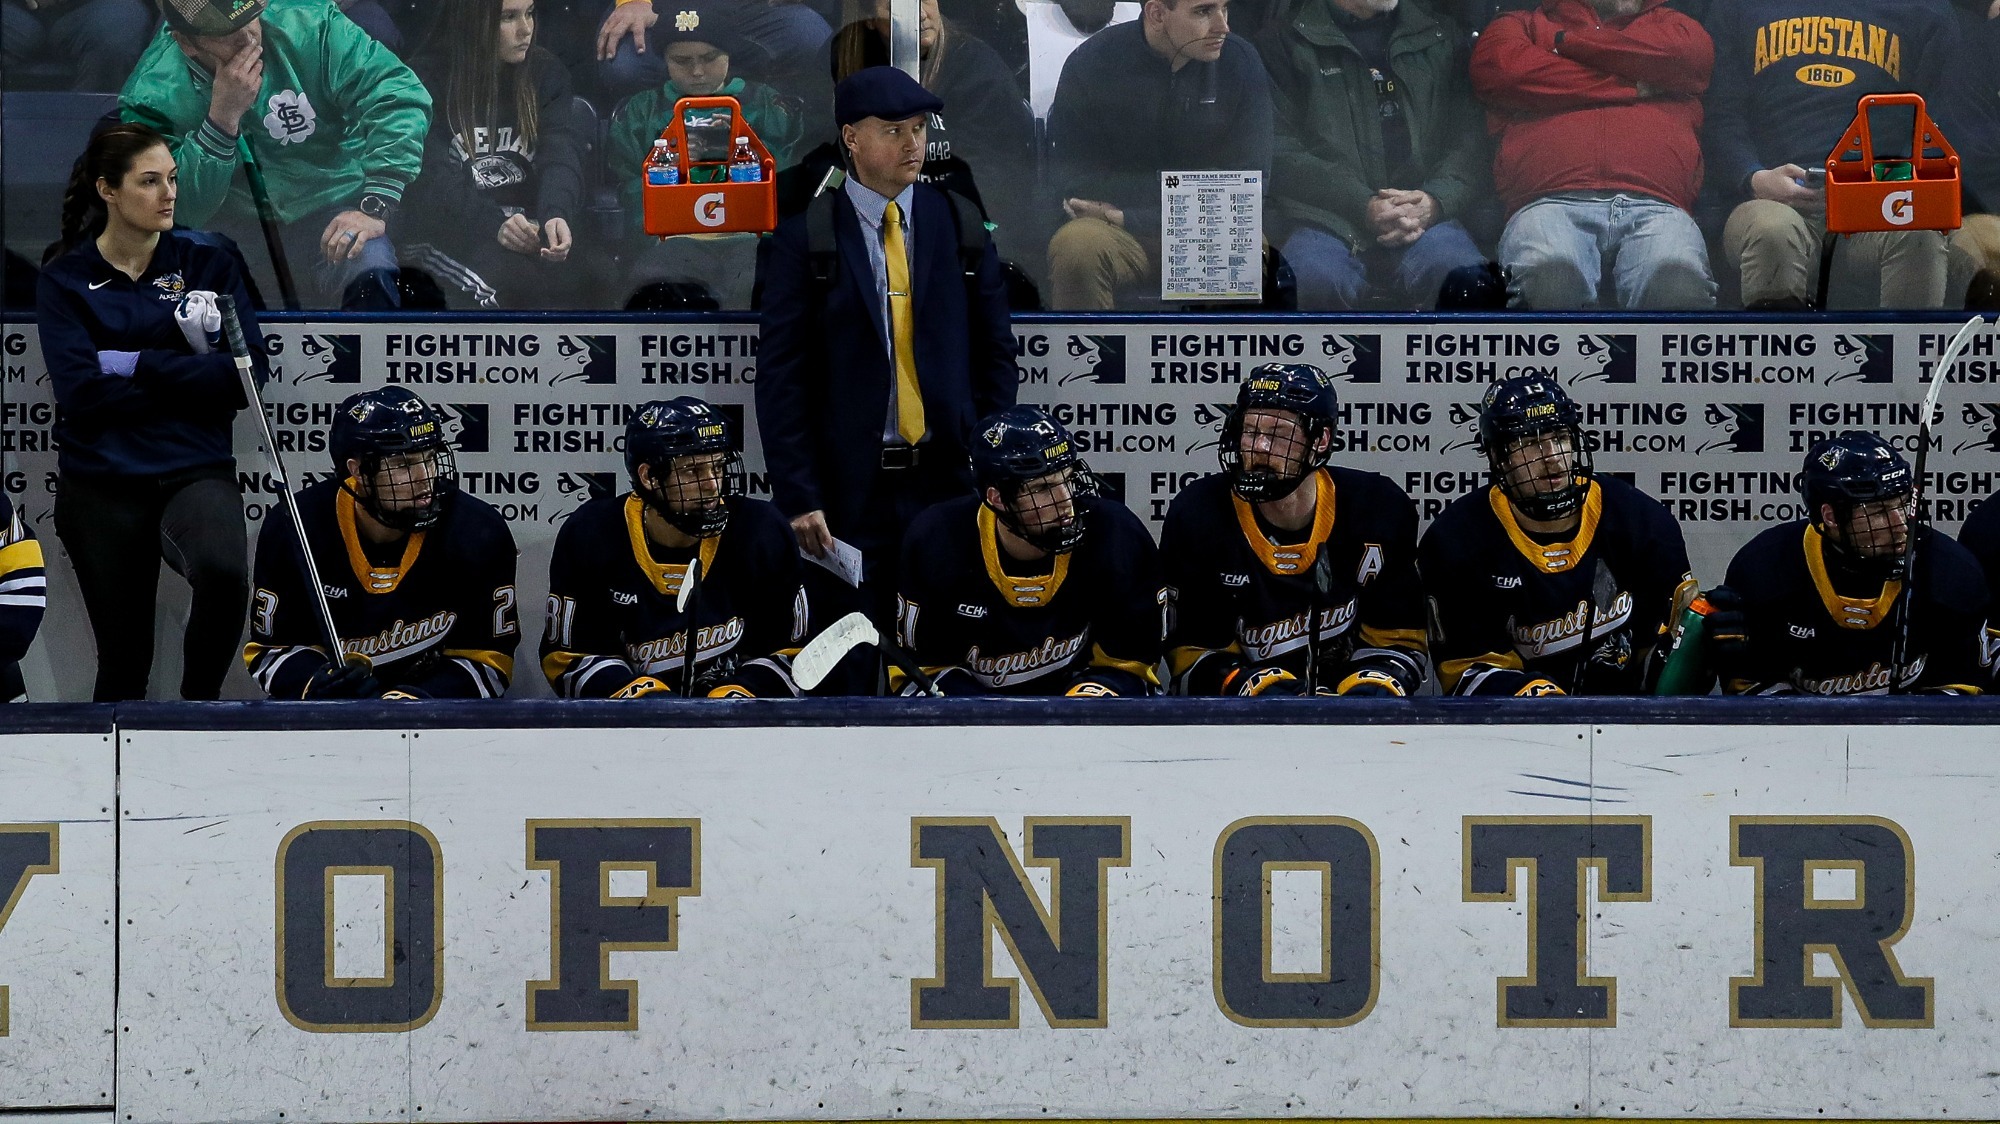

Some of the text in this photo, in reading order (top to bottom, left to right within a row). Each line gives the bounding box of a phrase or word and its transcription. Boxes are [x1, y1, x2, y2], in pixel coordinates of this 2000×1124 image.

[229, 0, 255, 20] IRELAND
[1754, 16, 1901, 82] AUGUSTANA
[1807, 68, 1843, 84] 1860
[694, 192, 726, 227] G
[1882, 190, 1914, 226] G
[386, 334, 540, 357] FIGHTING
[1151, 334, 1305, 357] FIGHTING
[1406, 334, 1560, 357] FIGHTING
[1661, 334, 1816, 357] FIGHTING
[386, 361, 539, 384] IRISH.COM
[1661, 361, 1815, 384] IRISH.COM
[1251, 380, 1280, 391] VIKINGS
[1526, 403, 1556, 418] VIKINGS
[410, 422, 435, 437] VIKINGS
[697, 424, 723, 438] VIKINGS
[1044, 441, 1069, 459] VIKINGS
[1882, 468, 1905, 481] CCM
[1547, 498, 1575, 510] CCM
[1911, 487, 1919, 517] CCM
[1356, 543, 1384, 587] A
[254, 588, 278, 637] 3
[493, 585, 516, 638] 2
[545, 594, 577, 648] 81
[275, 818, 701, 1034] OF
[911, 816, 1935, 1030] NOTR
